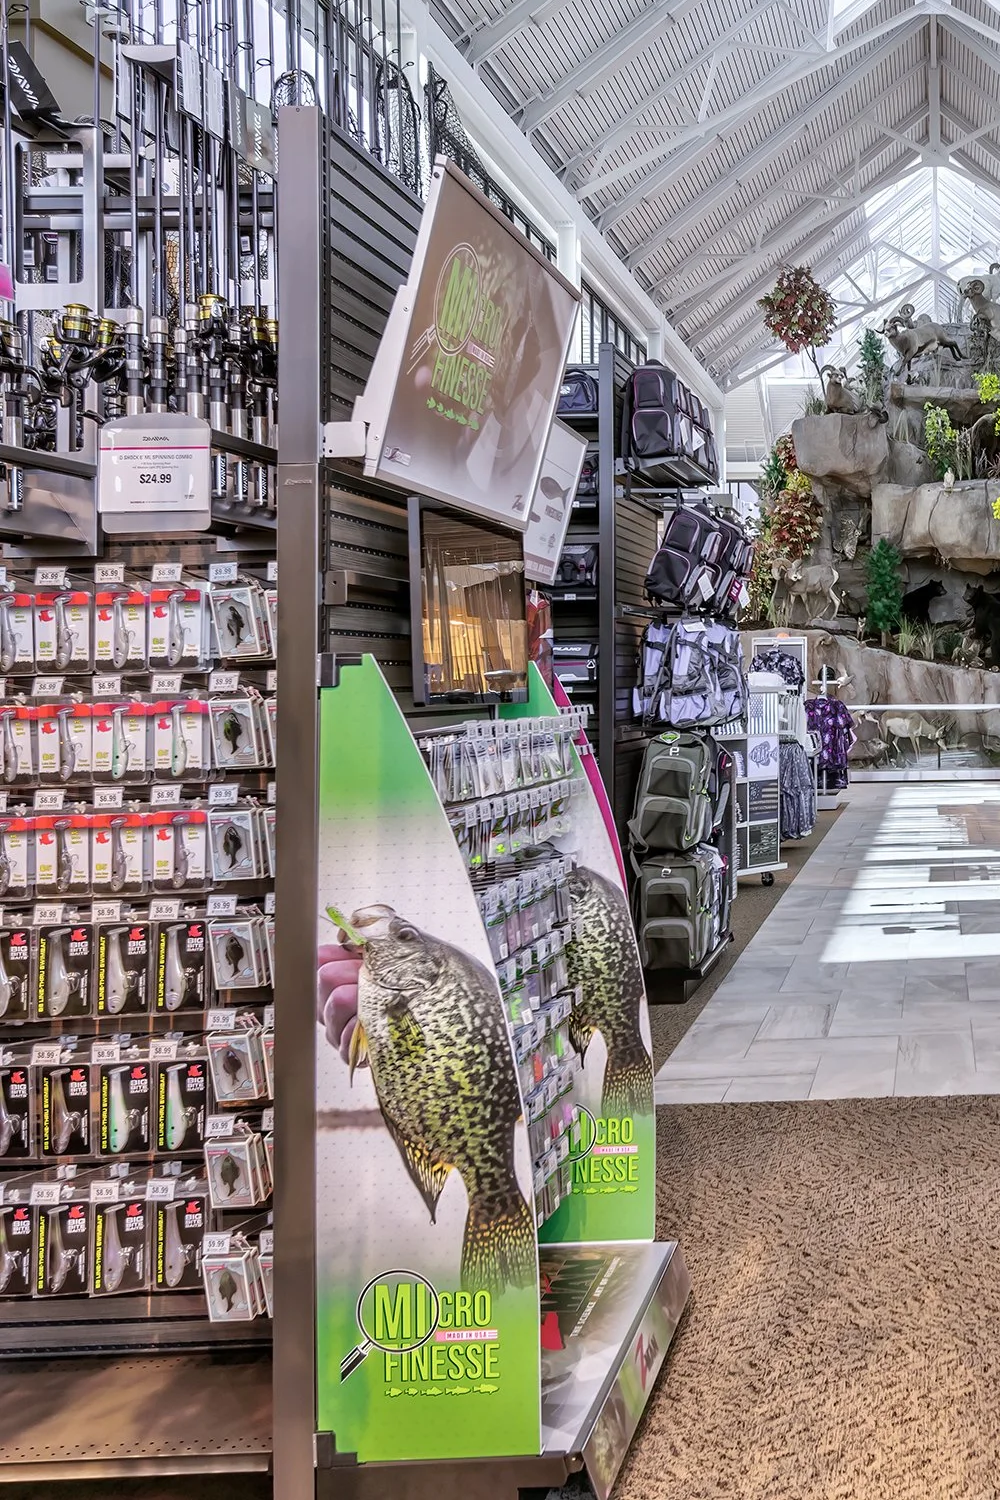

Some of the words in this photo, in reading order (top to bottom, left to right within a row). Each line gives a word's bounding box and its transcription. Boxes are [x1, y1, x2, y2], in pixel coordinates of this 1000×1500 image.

[431, 340, 493, 416] FINESSE
[140, 474, 171, 484] $24.99
[41, 572, 58, 580] $6.99
[158, 680, 175, 688] $6.99
[40, 796, 57, 804] $6.99
[39, 910, 57, 918] $8.99
[574, 1154, 638, 1184] NESSE
[374, 1283, 492, 1340] MICRO
[384, 1343, 500, 1382] FINESSE
